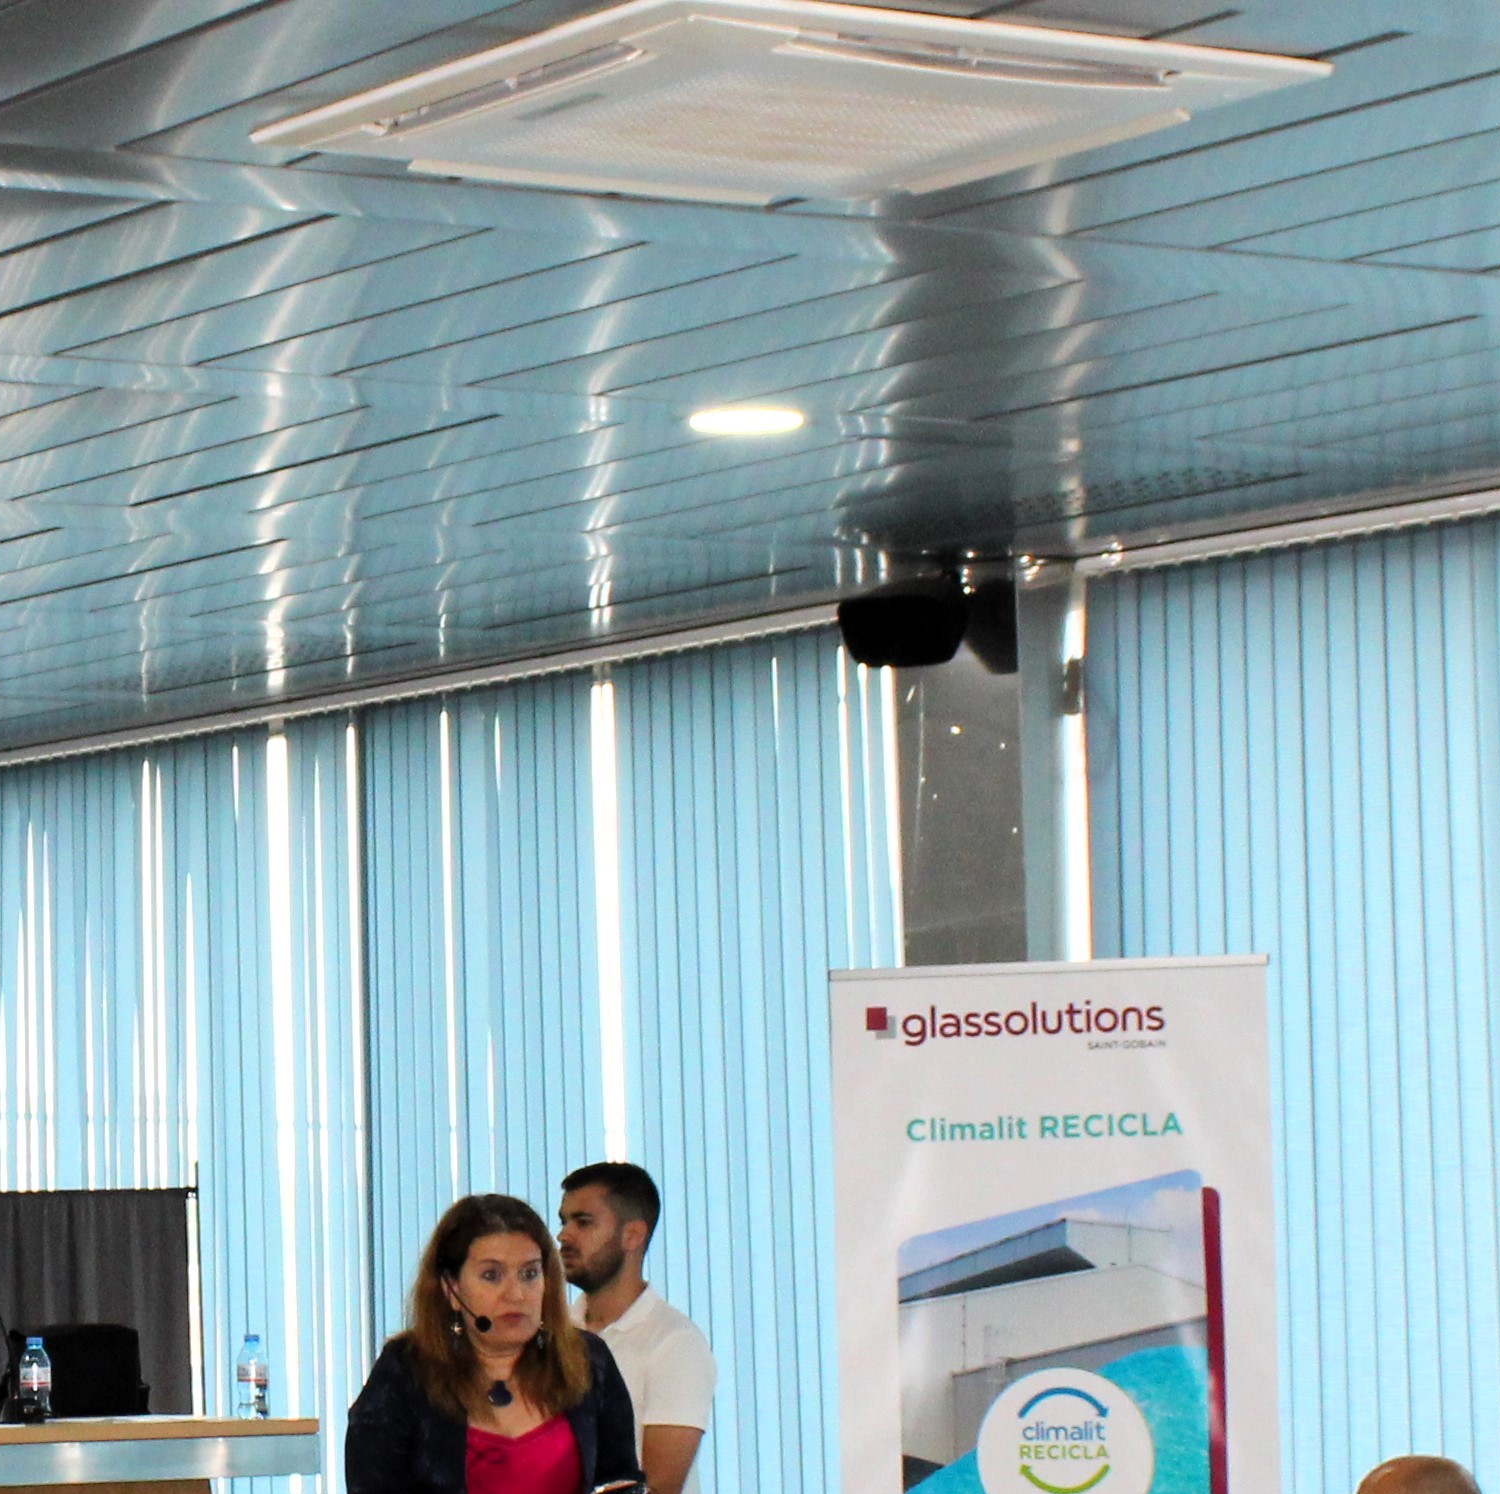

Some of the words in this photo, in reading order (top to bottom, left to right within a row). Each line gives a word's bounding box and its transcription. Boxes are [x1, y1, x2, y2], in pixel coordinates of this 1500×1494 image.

[901, 1000, 1165, 1047] glassolutions
[1087, 1038, 1167, 1050] SAINT-GOBAIN
[906, 1115, 1028, 1142] Climalit
[1039, 1112, 1183, 1139] RECICLA
[1022, 1420, 1106, 1442] climalit
[1020, 1443, 1110, 1461] RECICLA
